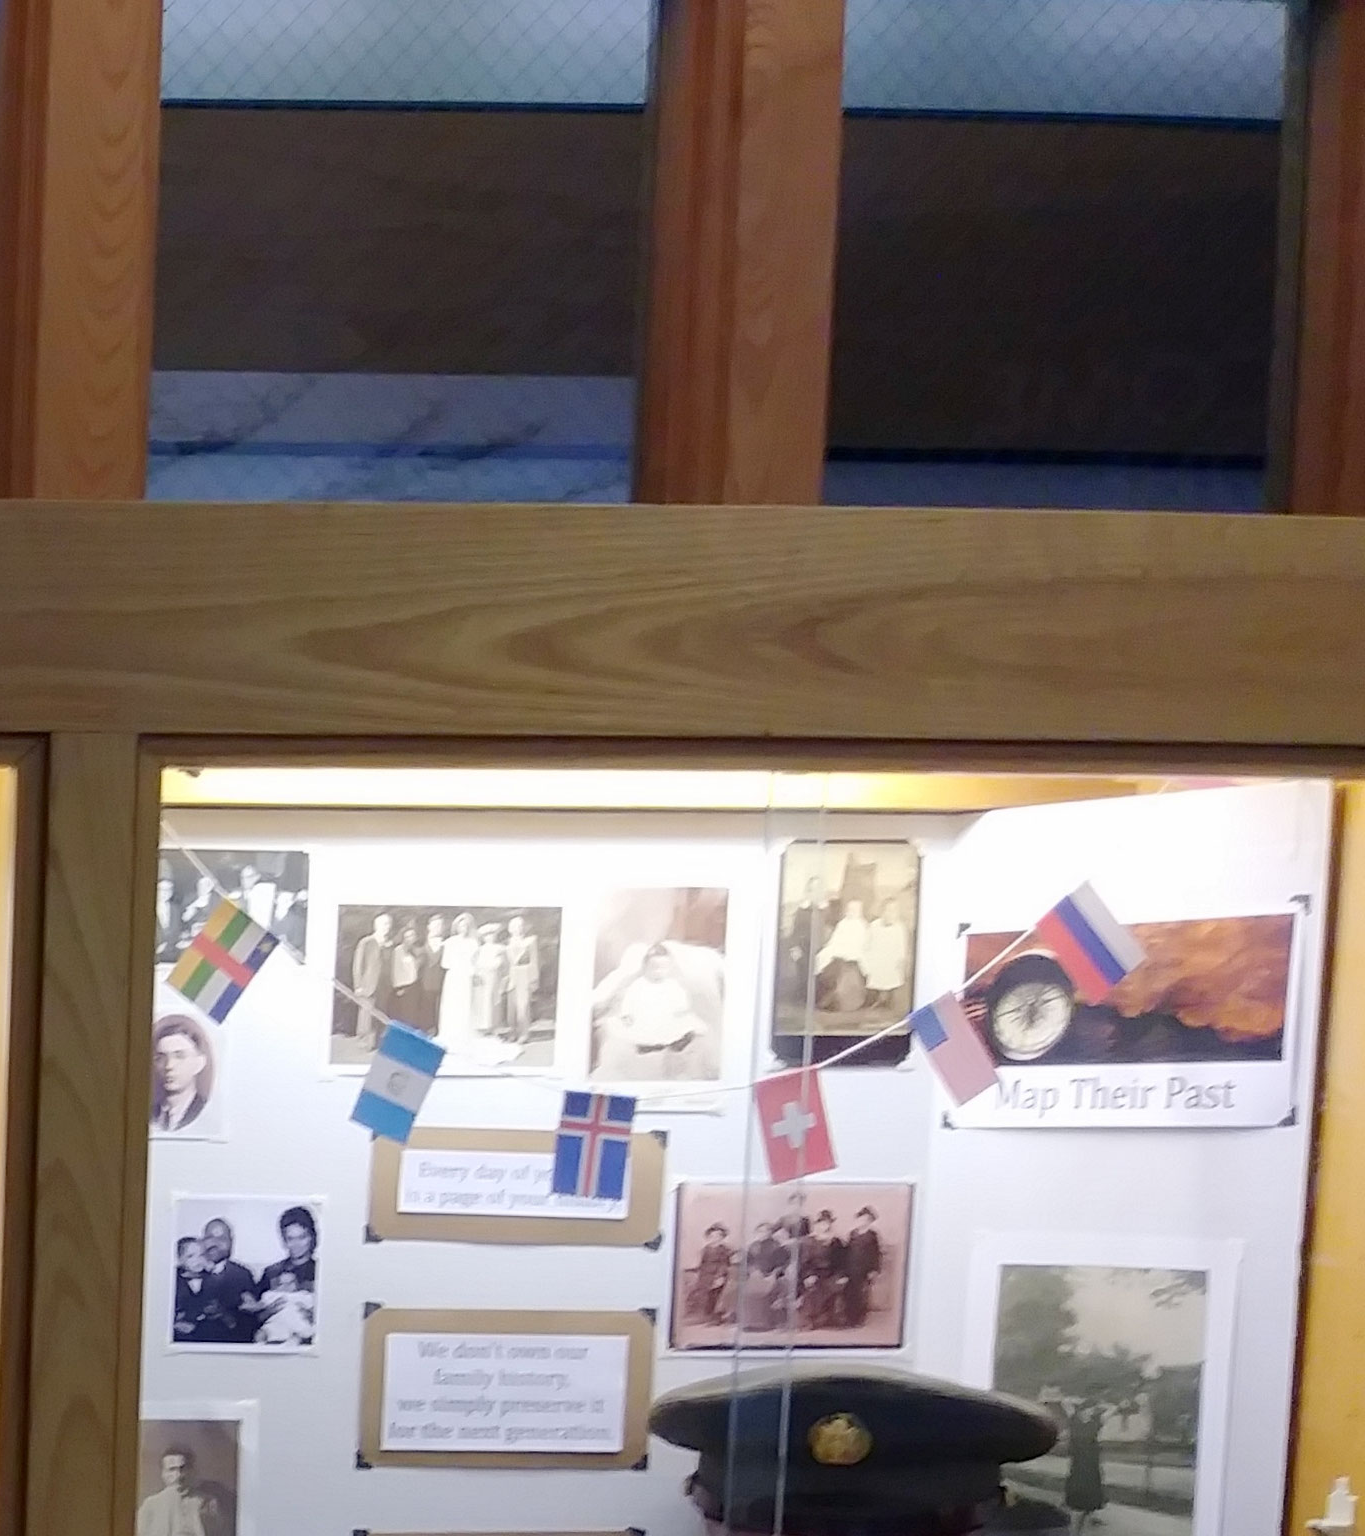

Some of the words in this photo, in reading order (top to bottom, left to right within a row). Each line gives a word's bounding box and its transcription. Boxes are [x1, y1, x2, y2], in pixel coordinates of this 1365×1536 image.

[994, 1078, 1059, 1119] Map
[1071, 1076, 1158, 1111] Their
[1164, 1075, 1237, 1110] Past
[418, 1161, 469, 1182] Every
